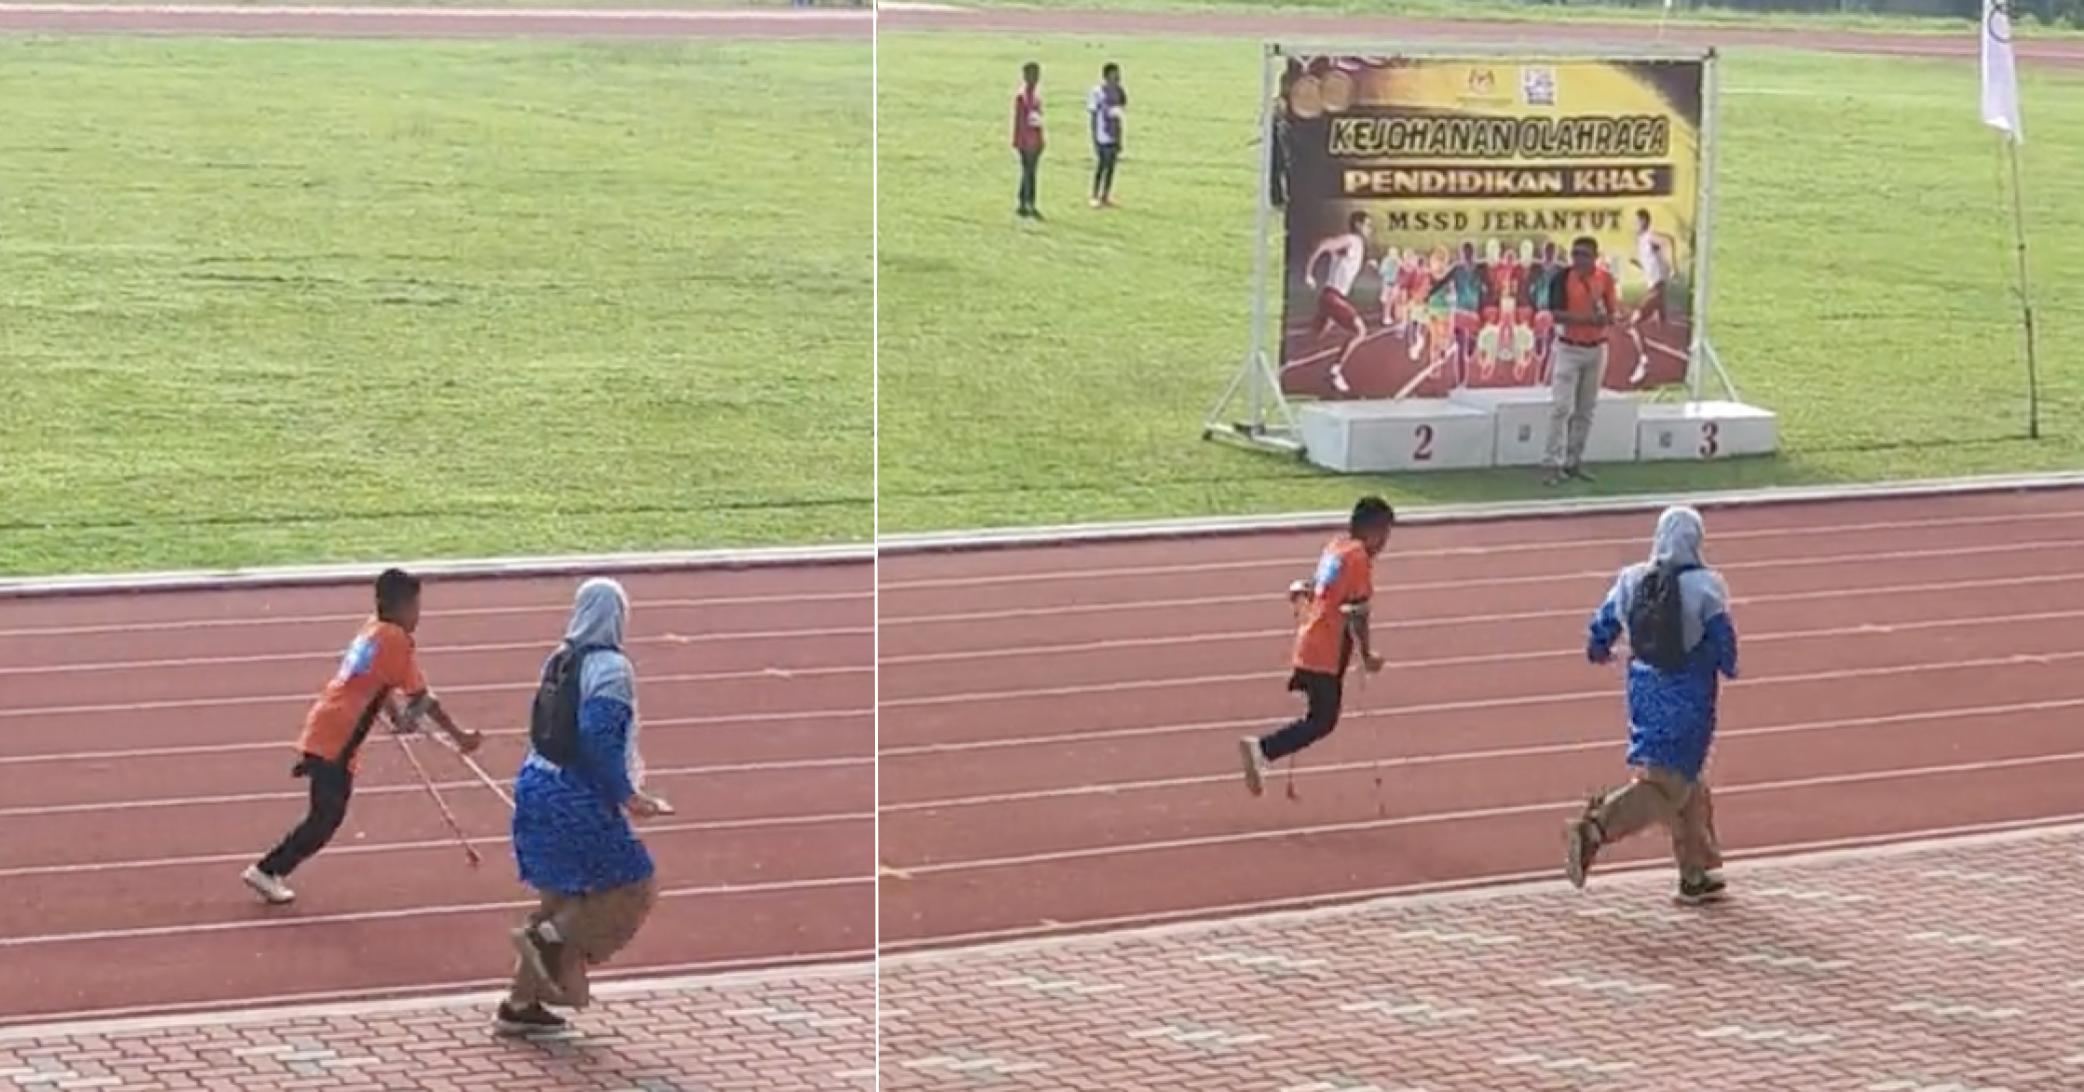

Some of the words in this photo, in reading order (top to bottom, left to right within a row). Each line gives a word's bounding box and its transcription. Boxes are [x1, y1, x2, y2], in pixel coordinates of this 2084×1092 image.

[1329, 116, 1515, 157] KEJOHANAN
[1344, 169, 1564, 194] PENDIDIKAN
[1572, 168, 1656, 191] KHAS
[1387, 211, 1469, 232] MSSD
[1479, 209, 1623, 231] JERANTUT
[1413, 424, 1434, 461] 2
[1699, 422, 1719, 457] 3
